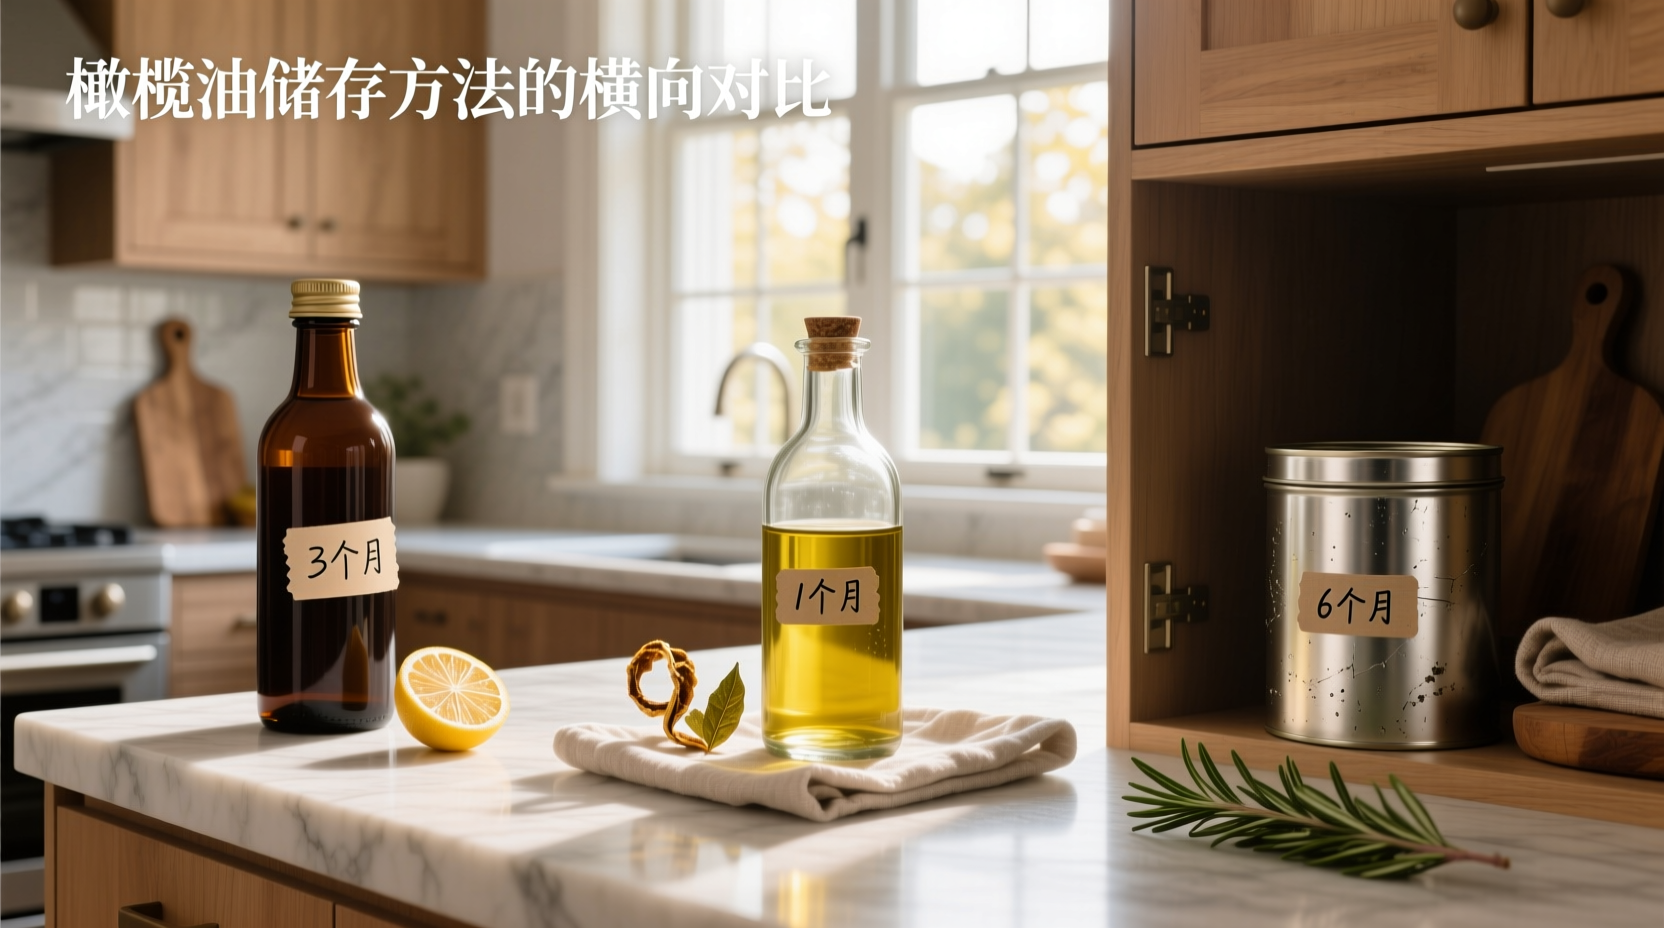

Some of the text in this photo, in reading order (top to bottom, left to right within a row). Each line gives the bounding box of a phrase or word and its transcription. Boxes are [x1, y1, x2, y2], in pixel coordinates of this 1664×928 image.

[307, 538, 381, 580] 3个月
[795, 577, 860, 616] 1个月
[1316, 586, 1392, 626] 6个月
